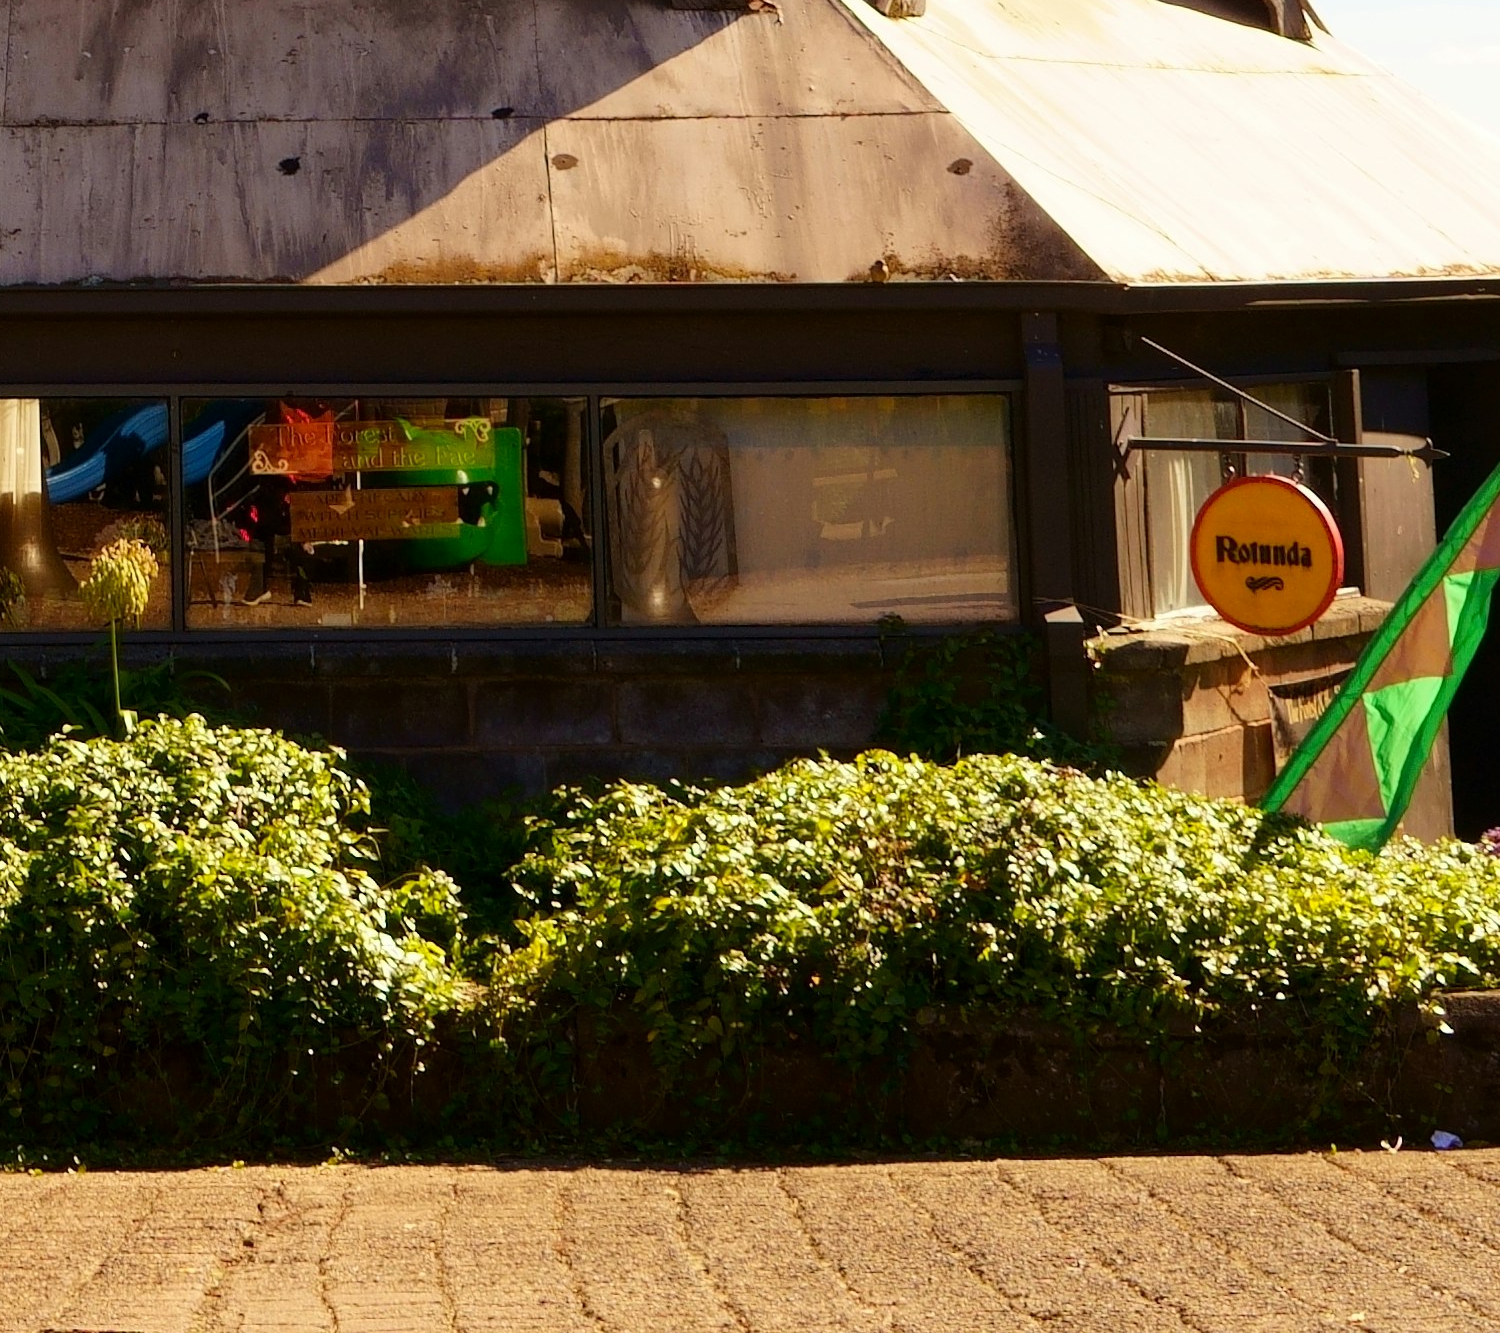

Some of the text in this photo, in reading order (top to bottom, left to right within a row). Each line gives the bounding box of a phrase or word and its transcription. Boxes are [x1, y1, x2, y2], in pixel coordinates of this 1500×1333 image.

[342, 448, 384, 470] and
[392, 446, 426, 467] the
[1215, 535, 1313, 568] Rotunda
